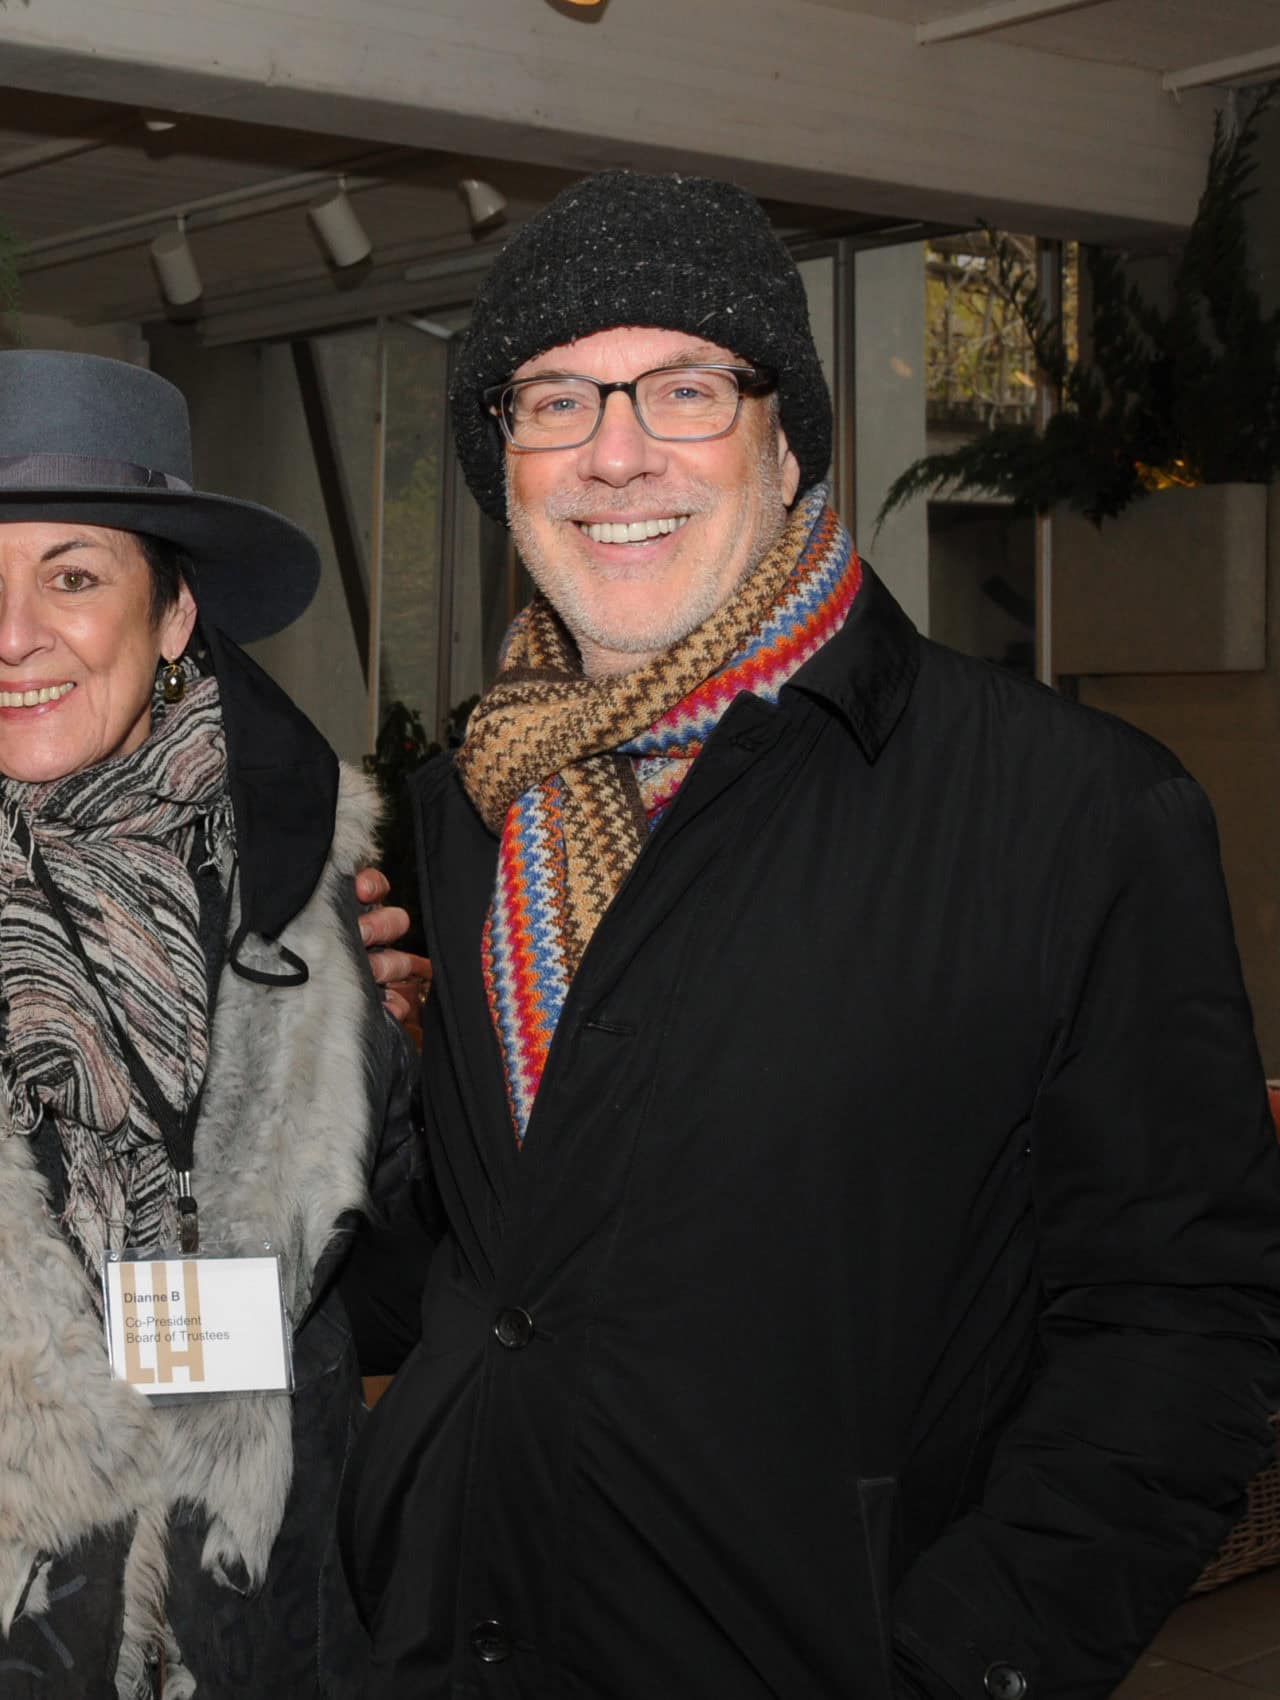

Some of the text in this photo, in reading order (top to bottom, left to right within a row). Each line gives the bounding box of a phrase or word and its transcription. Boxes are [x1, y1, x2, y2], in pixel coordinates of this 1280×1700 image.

[124, 1291, 181, 1303] Dianne B
[125, 1316, 202, 1328] Co-President
[126, 1331, 231, 1343] Board of Trustees
